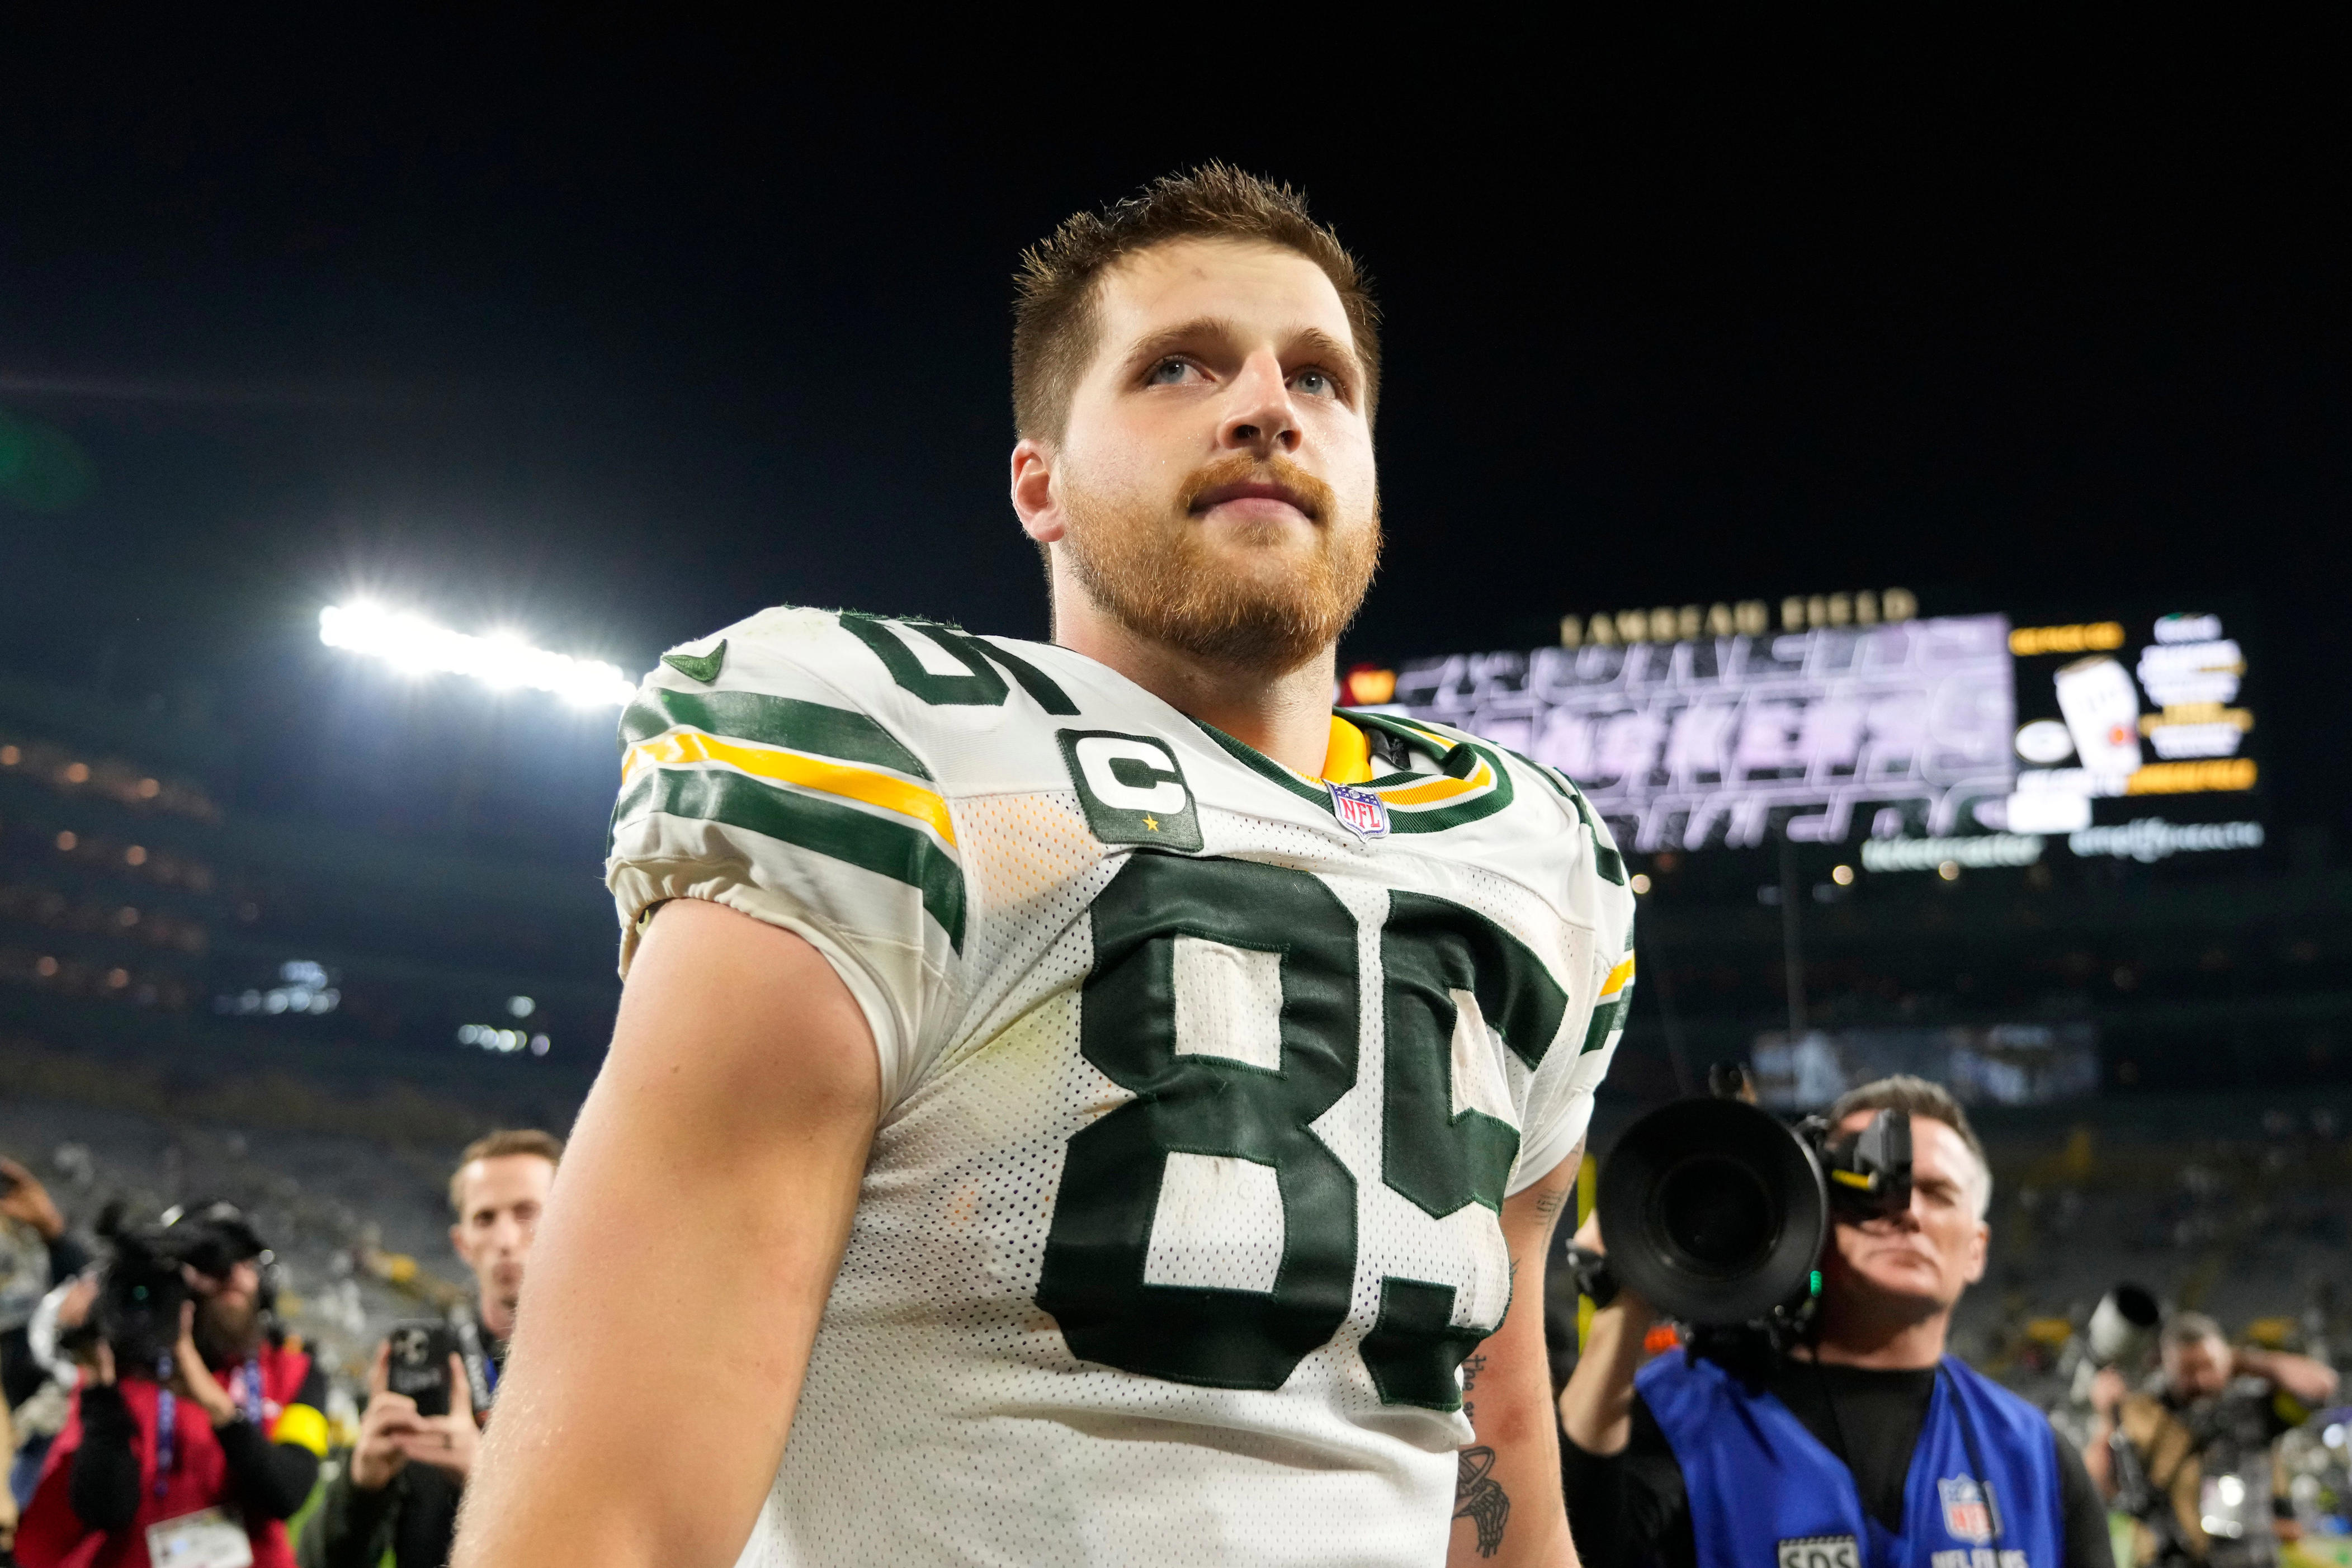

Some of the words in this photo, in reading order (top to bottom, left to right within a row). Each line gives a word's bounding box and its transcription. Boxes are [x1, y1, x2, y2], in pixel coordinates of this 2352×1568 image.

[1076, 736, 1186, 815] C
[1340, 797, 1381, 829] NFL
[1035, 850, 1569, 1413] 85
